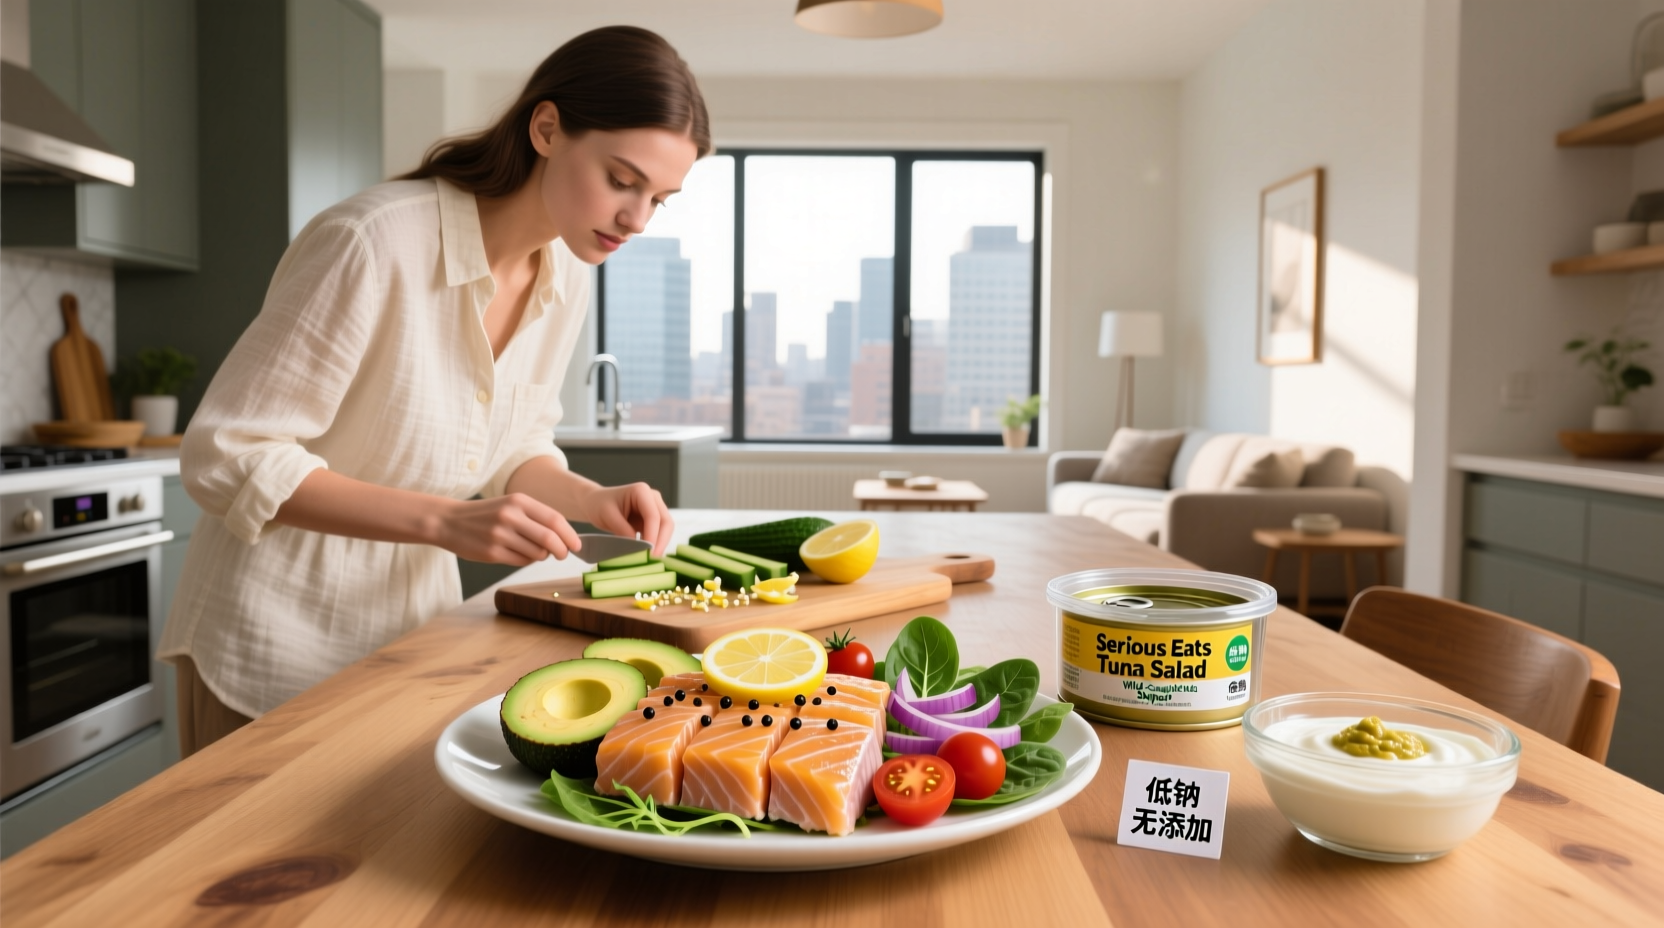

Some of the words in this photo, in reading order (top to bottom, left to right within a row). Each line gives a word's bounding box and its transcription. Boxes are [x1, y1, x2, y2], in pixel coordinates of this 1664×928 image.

[1096, 633, 1167, 657] Serious
[1171, 639, 1212, 657] Eats
[1097, 654, 1144, 677] Tuna
[1150, 659, 1207, 679] Salad
[1145, 776, 1201, 808] 低钠
[1130, 807, 1213, 843] 无添加
